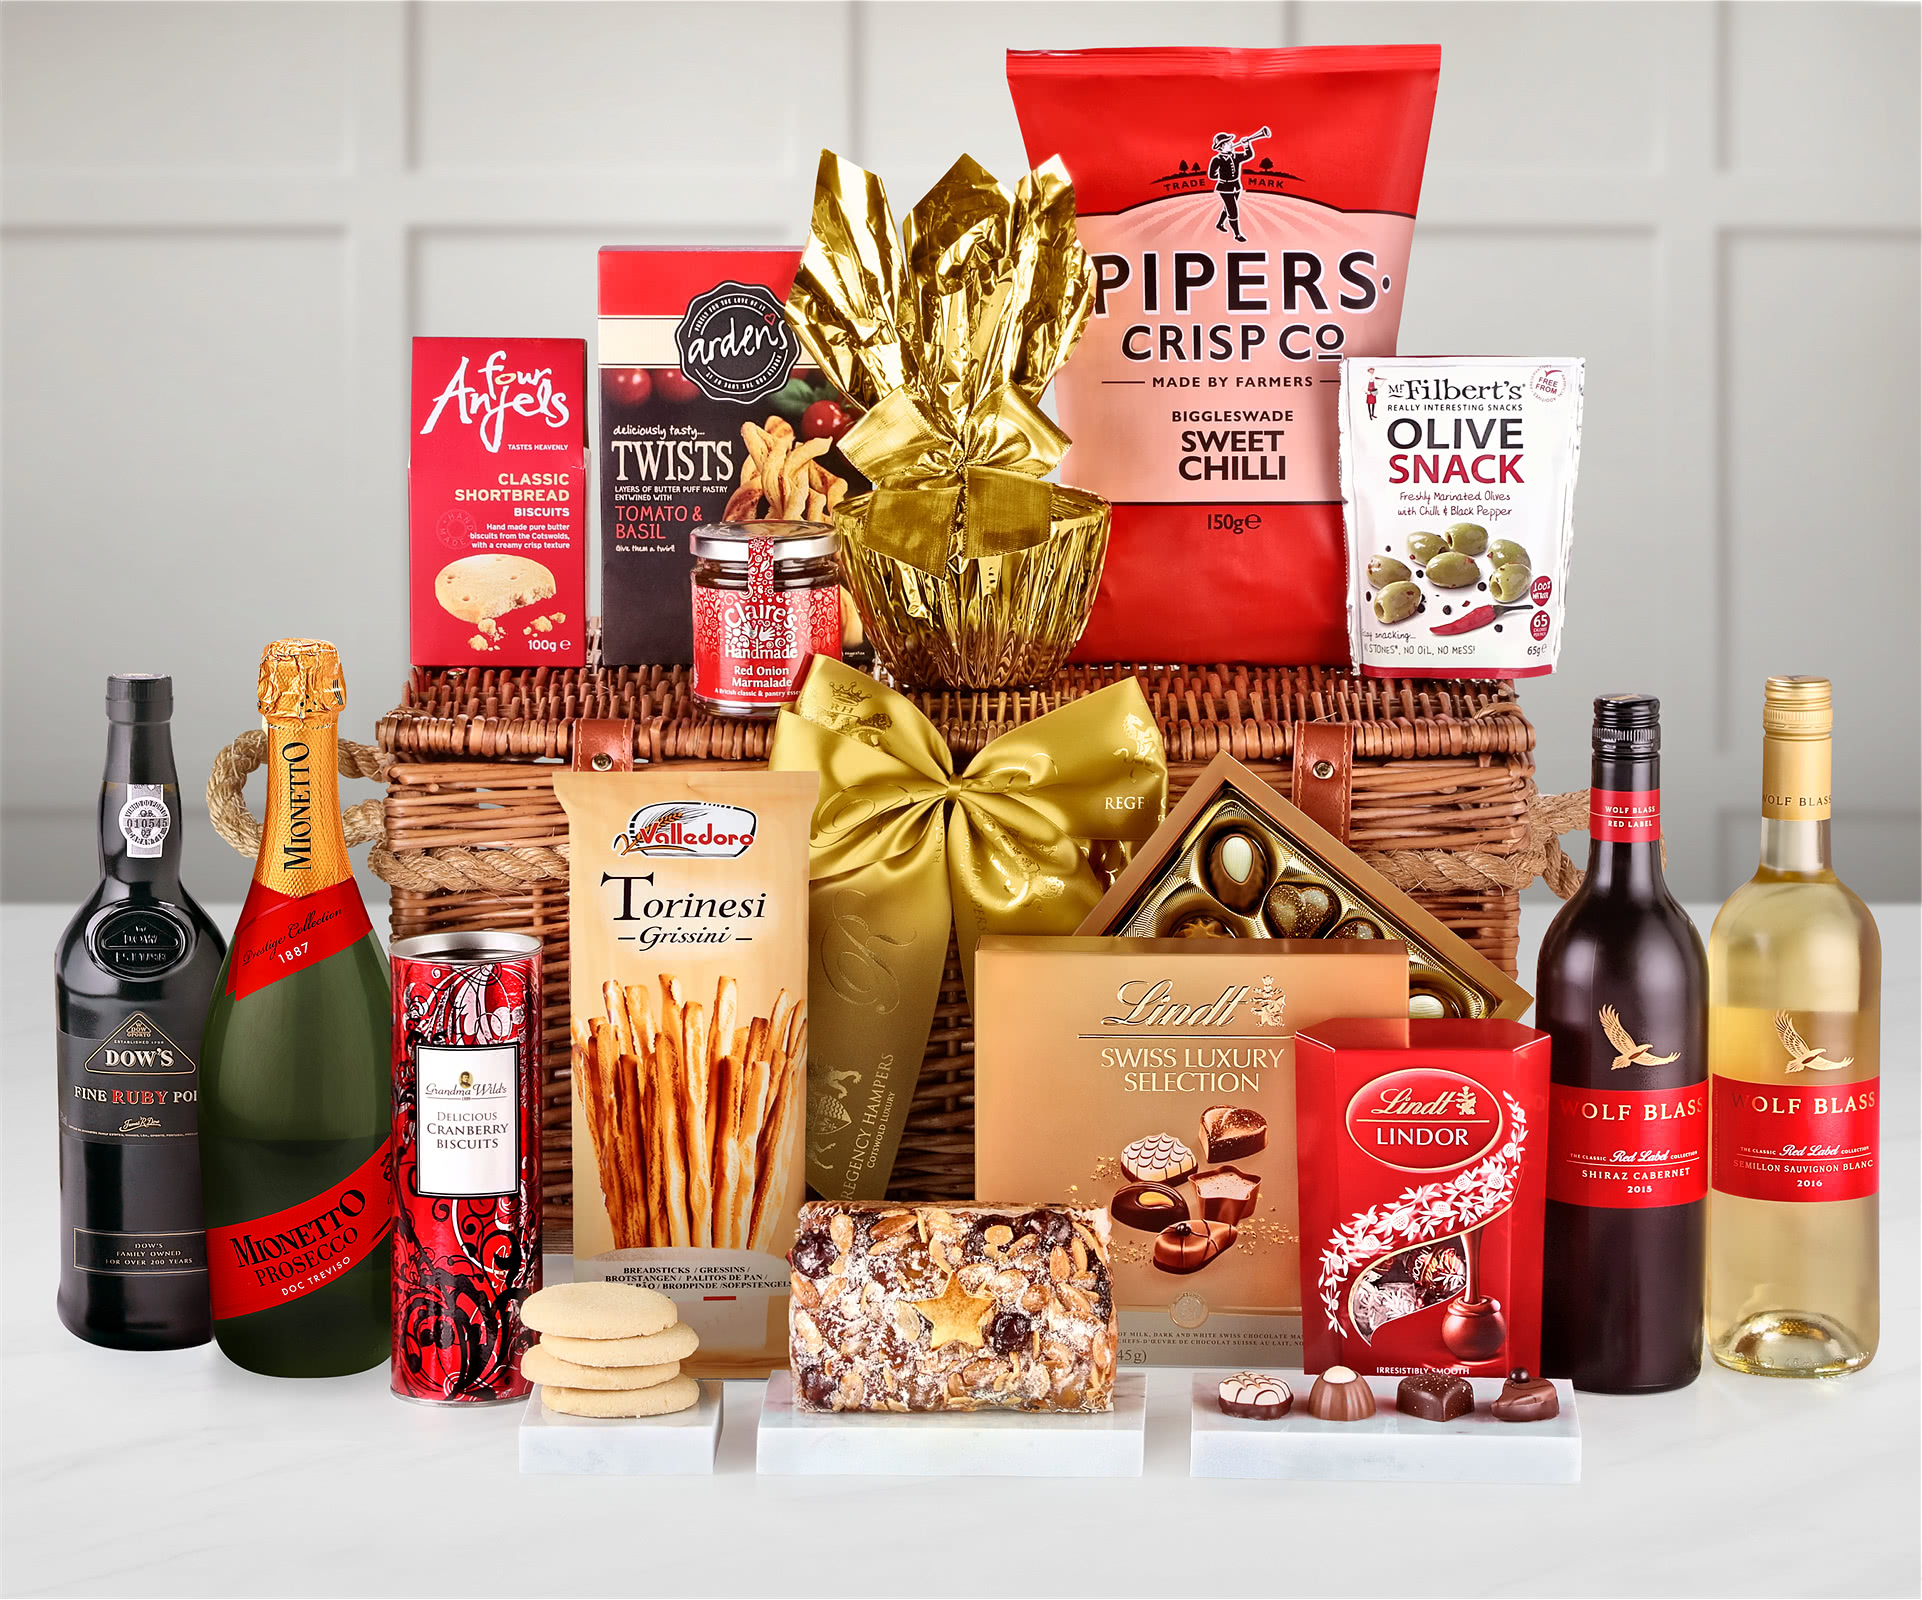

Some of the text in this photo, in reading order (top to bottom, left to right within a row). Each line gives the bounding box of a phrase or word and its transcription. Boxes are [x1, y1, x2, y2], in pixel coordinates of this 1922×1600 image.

[1163, 178, 1285, 191] TRADE MARK
[1092, 250, 1380, 317] PIPERS
[1121, 323, 1267, 363] CRISP
[478, 350, 552, 399] four
[1152, 375, 1313, 388] MADE BY FARMERS
[1538, 376, 1559, 388] FREE
[1404, 378, 1523, 400] Filbert's
[1535, 383, 1558, 395] FROM
[1387, 404, 1523, 412] REALLY INTERESTING SNACKS
[1171, 410, 1294, 423] BIGGLESWADE
[613, 424, 667, 440] deliciously
[1387, 417, 1523, 450] OLIVE
[1181, 429, 1285, 453] SWEET
[611, 440, 734, 482] TWISTS
[1178, 455, 1286, 482] CHILLI
[1388, 454, 1525, 484] SNACK
[498, 473, 570, 486] CLASSIC
[454, 489, 570, 502] SHORTBREAD
[614, 485, 729, 493] LAYERS OF BUTTER PUFF PASTRY
[1400, 490, 1511, 505] Freshly Marinated Olives
[513, 507, 570, 517] BISCUITS
[614, 505, 703, 522] TOMATO &
[1397, 506, 1417, 516] with
[1419, 505, 1440, 516] Chilli
[1450, 505, 1474, 516] Black
[1476, 504, 1512, 521] Pepper
[486, 523, 571, 532] Hand made pure butter
[615, 523, 667, 539] BASIL
[469, 532, 571, 541] biscuits from the Cotswolds,
[471, 541, 488, 549] with
[495, 542, 523, 550] creamy
[523, 541, 543, 550] crisp
[543, 541, 571, 549] texture
[724, 601, 798, 630] Claire's
[1533, 614, 1548, 628] 65
[527, 639, 557, 652] 100g
[724, 643, 799, 660] Handmade
[734, 665, 790, 676] Red Onion
[731, 677, 793, 688] Marmalade
[1632, 805, 1656, 814] BLASS
[1607, 820, 1653, 828] RED LABEL
[639, 823, 754, 846] Valledoro
[600, 871, 767, 921] Torinesi
[242, 908, 342, 967] Prestige Collection
[638, 926, 732, 952] Grissini
[278, 941, 310, 964] 1887
[1100, 979, 1250, 1027] Lindt
[105, 1047, 175, 1068] DOW'S
[1101, 1047, 1285, 1069] SWISS LUXURY
[425, 1083, 507, 1096] Grandma Wild's
[1124, 1072, 1260, 1093] SELECTION
[74, 1085, 107, 1103] FINE
[111, 1088, 168, 1106] RUBY
[1371, 1087, 1455, 1116] Lindt
[1731, 1091, 1876, 1115] WOLF BLASS
[1561, 1097, 1703, 1121] WOLF BLASS
[841, 1053, 894, 1200] REGENCY HAMPERS
[867, 1091, 896, 1169] COTSWOLD LUXURY
[1376, 1127, 1469, 1147] LINDOR
[1582, 1154, 1607, 1162] CLASSIC
[1609, 1150, 1636, 1163] Red
[1637, 1150, 1671, 1163] Label
[1670, 1150, 1698, 1160] COLLECTION
[1779, 1144, 1806, 1157] Red
[1807, 1144, 1841, 1157] Label
[1840, 1145, 1870, 1155] COLLECTION
[1581, 1167, 1691, 1181] SHIRAZ CABERNET
[1733, 1159, 1874, 1173] SEMILLON SAUVIGNON BLANC
[1627, 1185, 1653, 1194] 2015
[254, 1227, 358, 1287] PROSECCO
[281, 1256, 351, 1296] DOC TREVISO
[605, 1274, 677, 1282] BROTSTANGEN
[699, 1266, 745, 1274] GRESSINS
[1376, 1366, 1429, 1374] IRRESISTIBLY
